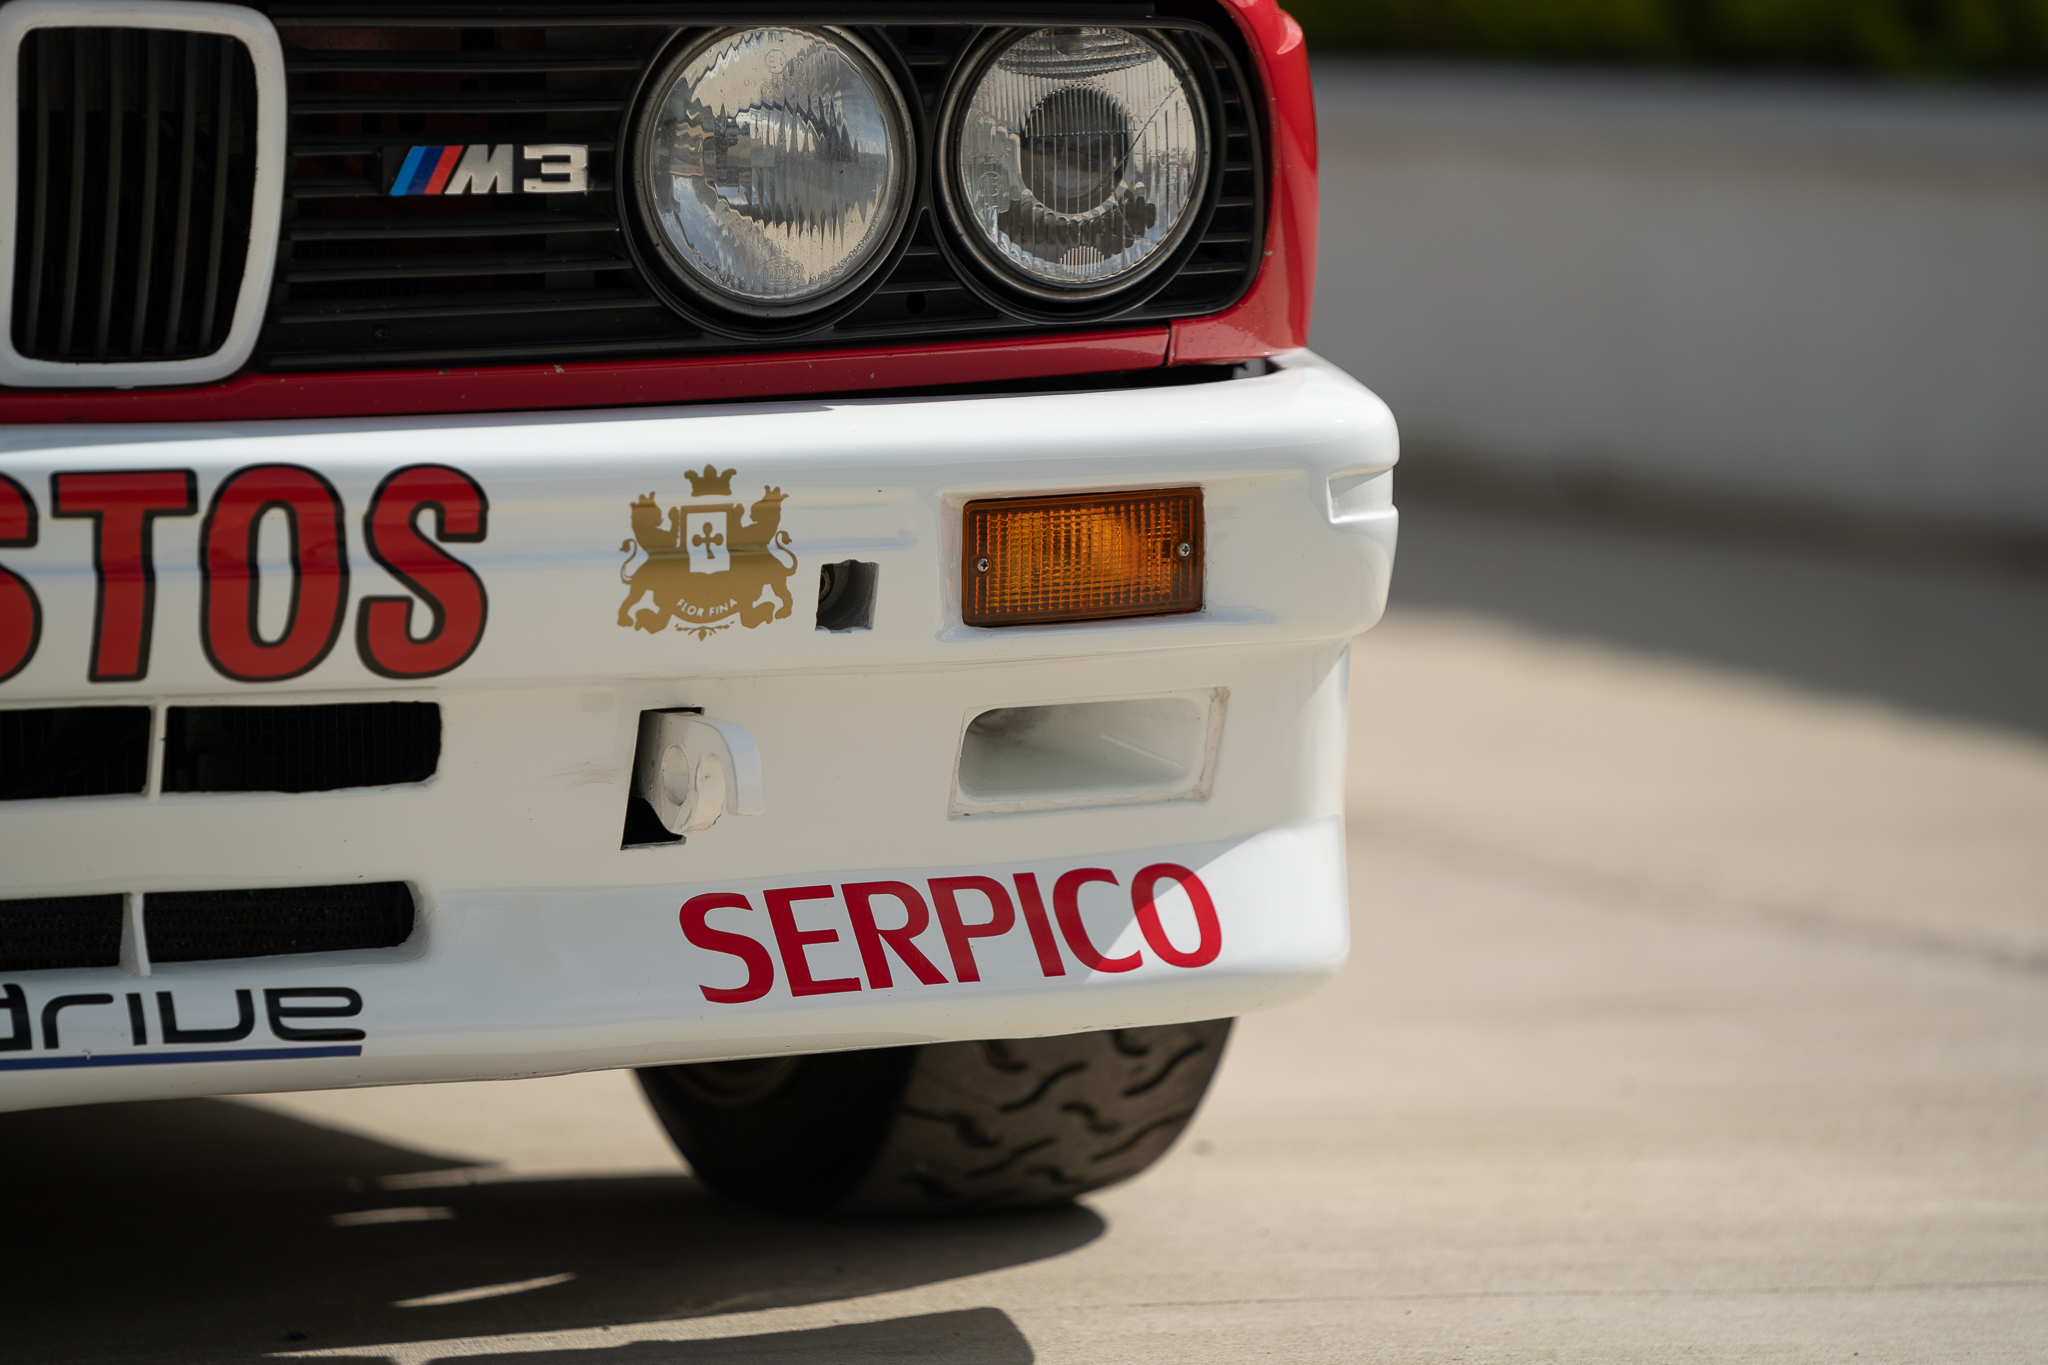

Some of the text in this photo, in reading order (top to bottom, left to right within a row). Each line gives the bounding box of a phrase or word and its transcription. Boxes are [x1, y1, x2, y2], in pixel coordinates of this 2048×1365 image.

[444, 144, 588, 195] M3
[676, 598, 738, 617] FLOR FINA
[679, 862, 1222, 1004] SERPICO
